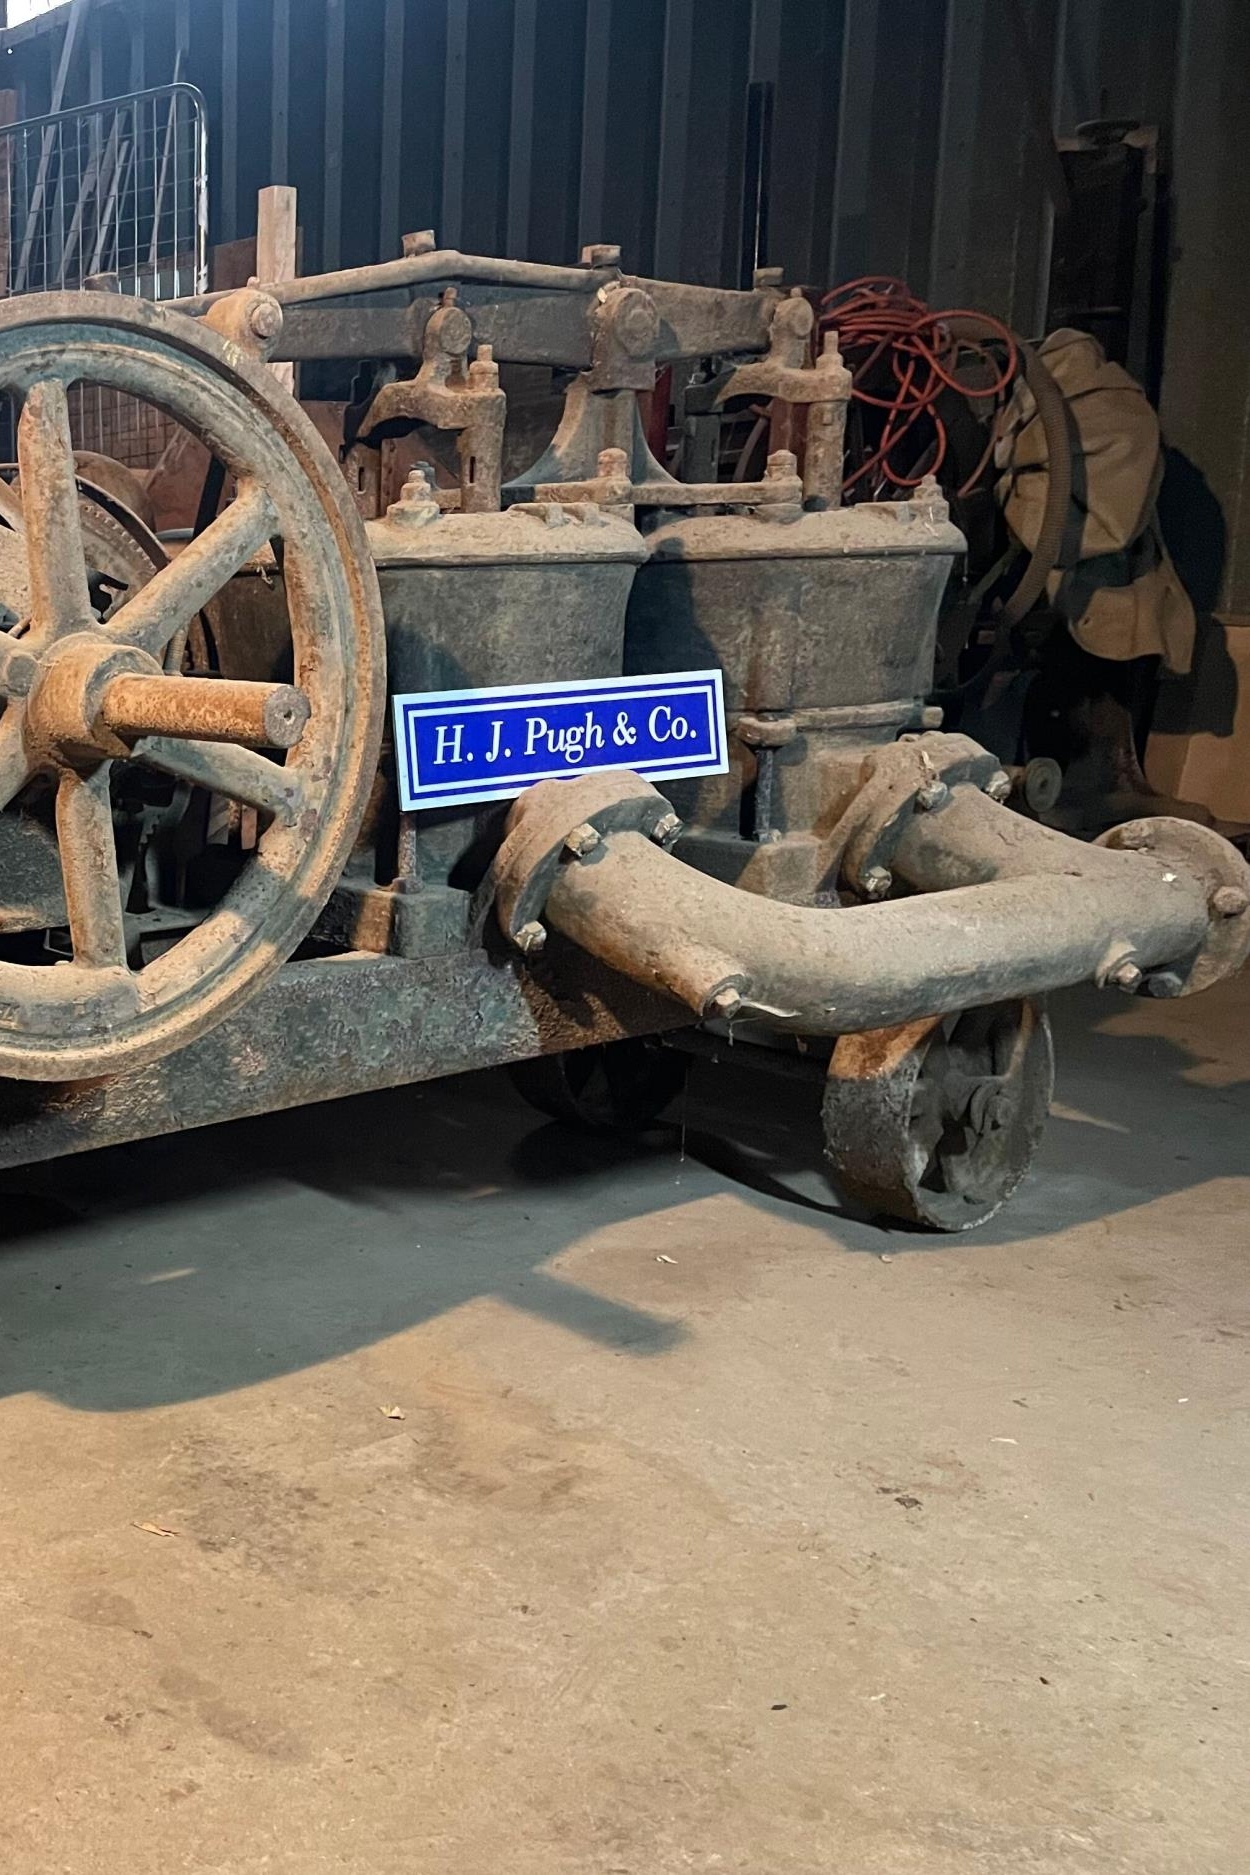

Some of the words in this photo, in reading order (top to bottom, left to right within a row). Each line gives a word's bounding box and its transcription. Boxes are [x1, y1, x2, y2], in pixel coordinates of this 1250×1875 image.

[433, 724, 474, 765] H.
[485, 720, 512, 763] J.
[523, 711, 605, 763] Pugh
[612, 711, 637, 746] &
[648, 705, 697, 743] Co.
